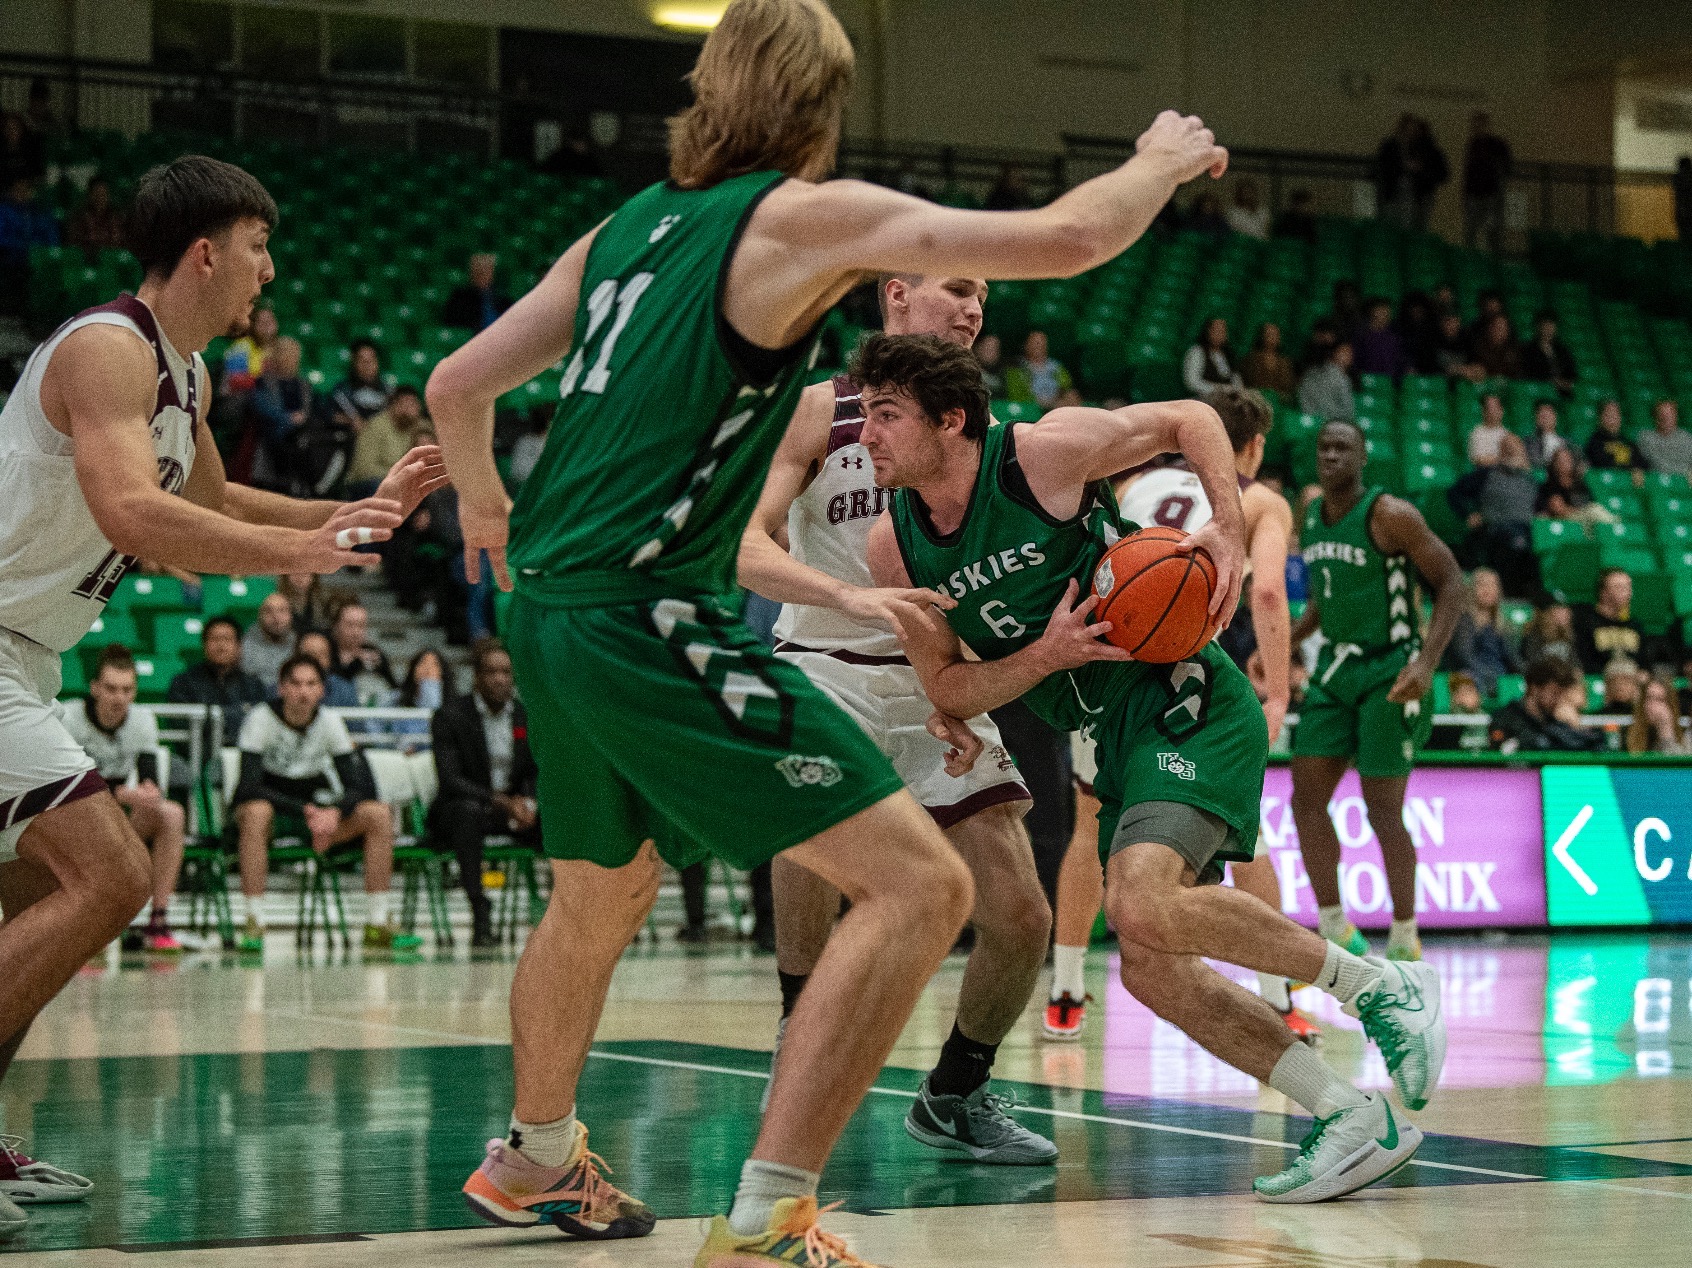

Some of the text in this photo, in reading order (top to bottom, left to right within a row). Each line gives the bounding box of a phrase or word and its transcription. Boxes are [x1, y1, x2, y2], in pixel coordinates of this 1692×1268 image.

[559, 272, 655, 399] 11
[980, 600, 1026, 639] 6
[1634, 817, 1692, 882] C
